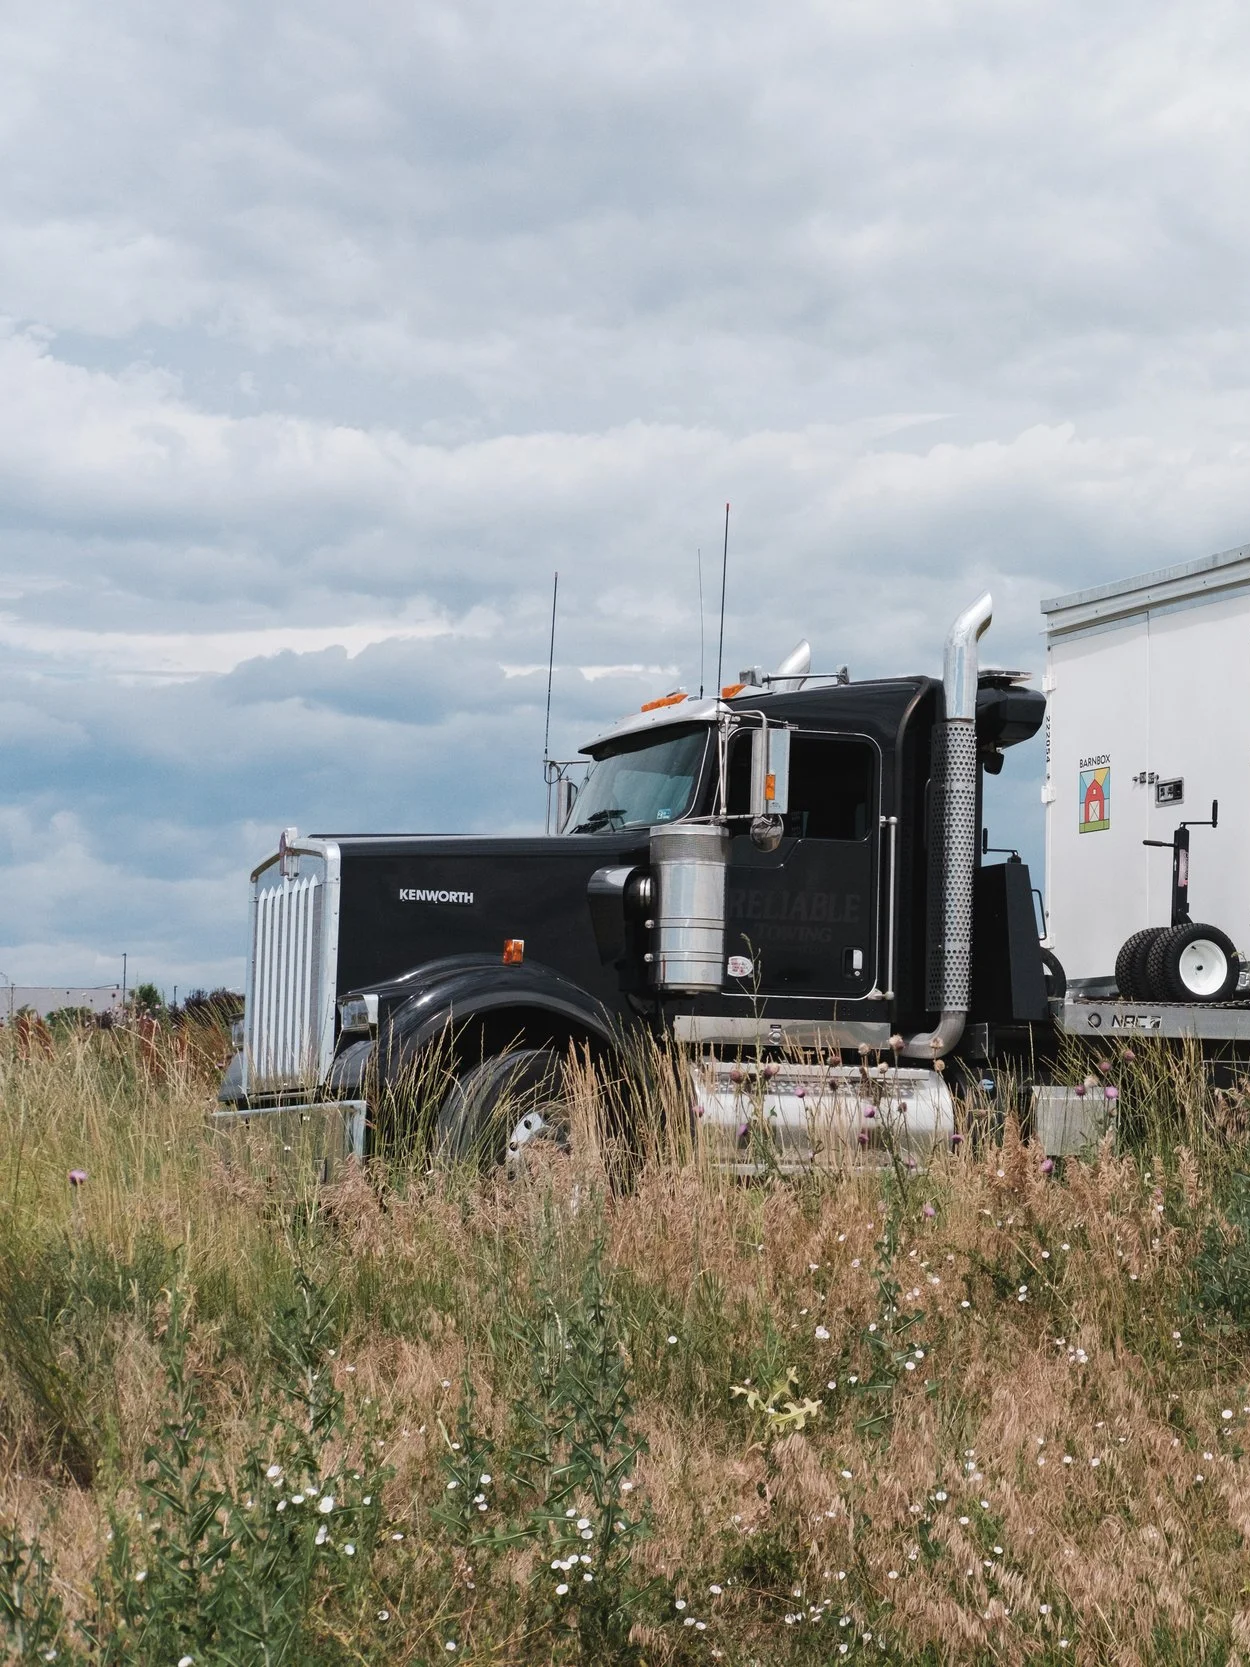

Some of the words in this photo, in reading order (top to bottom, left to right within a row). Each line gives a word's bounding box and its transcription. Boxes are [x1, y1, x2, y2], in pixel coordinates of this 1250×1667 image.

[1079, 754, 1111, 769] BARNBOX
[399, 888, 474, 904] KENWORTH
[729, 889, 861, 923] RELIABLE
[754, 923, 833, 943] TOWING
[1111, 1014, 1148, 1028] NRC
